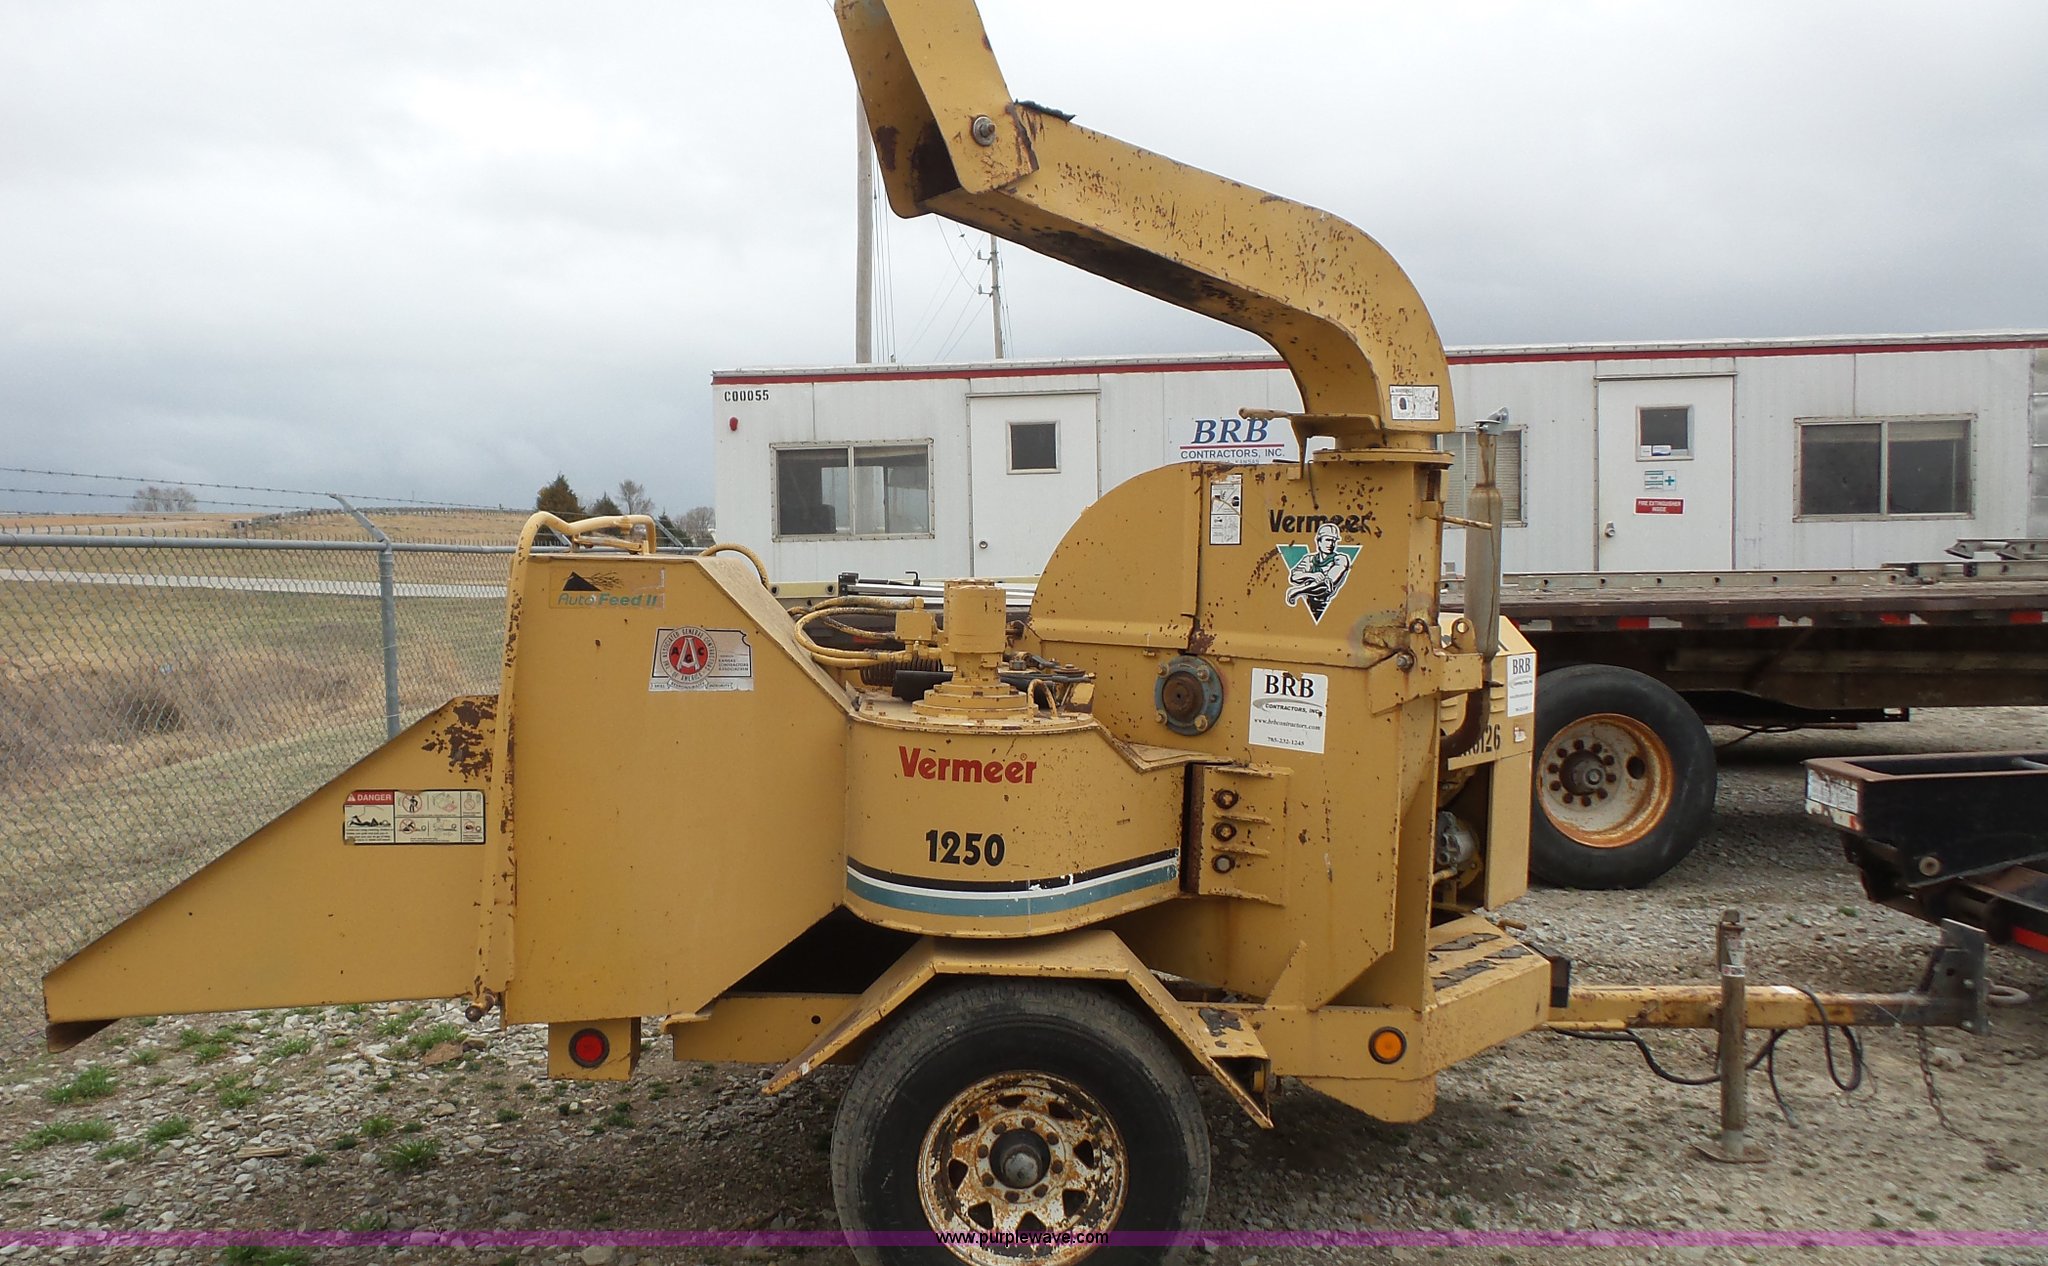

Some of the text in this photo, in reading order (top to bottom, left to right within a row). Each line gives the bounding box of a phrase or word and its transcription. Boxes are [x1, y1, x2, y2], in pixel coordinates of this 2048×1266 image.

[724, 389, 769, 402] C00055
[1191, 418, 1269, 444] BRB
[1180, 448, 1285, 460] CONTRACTORS, INC.
[1512, 658, 1532, 675] BRB
[1264, 673, 1314, 698] BRB
[1265, 703, 1308, 713] CONTRACTORS,
[1267, 736, 1305, 746] 785-232-1245
[898, 745, 1037, 784] Vermeer
[357, 793, 392, 802] DANGER
[925, 829, 1006, 867] 1250
